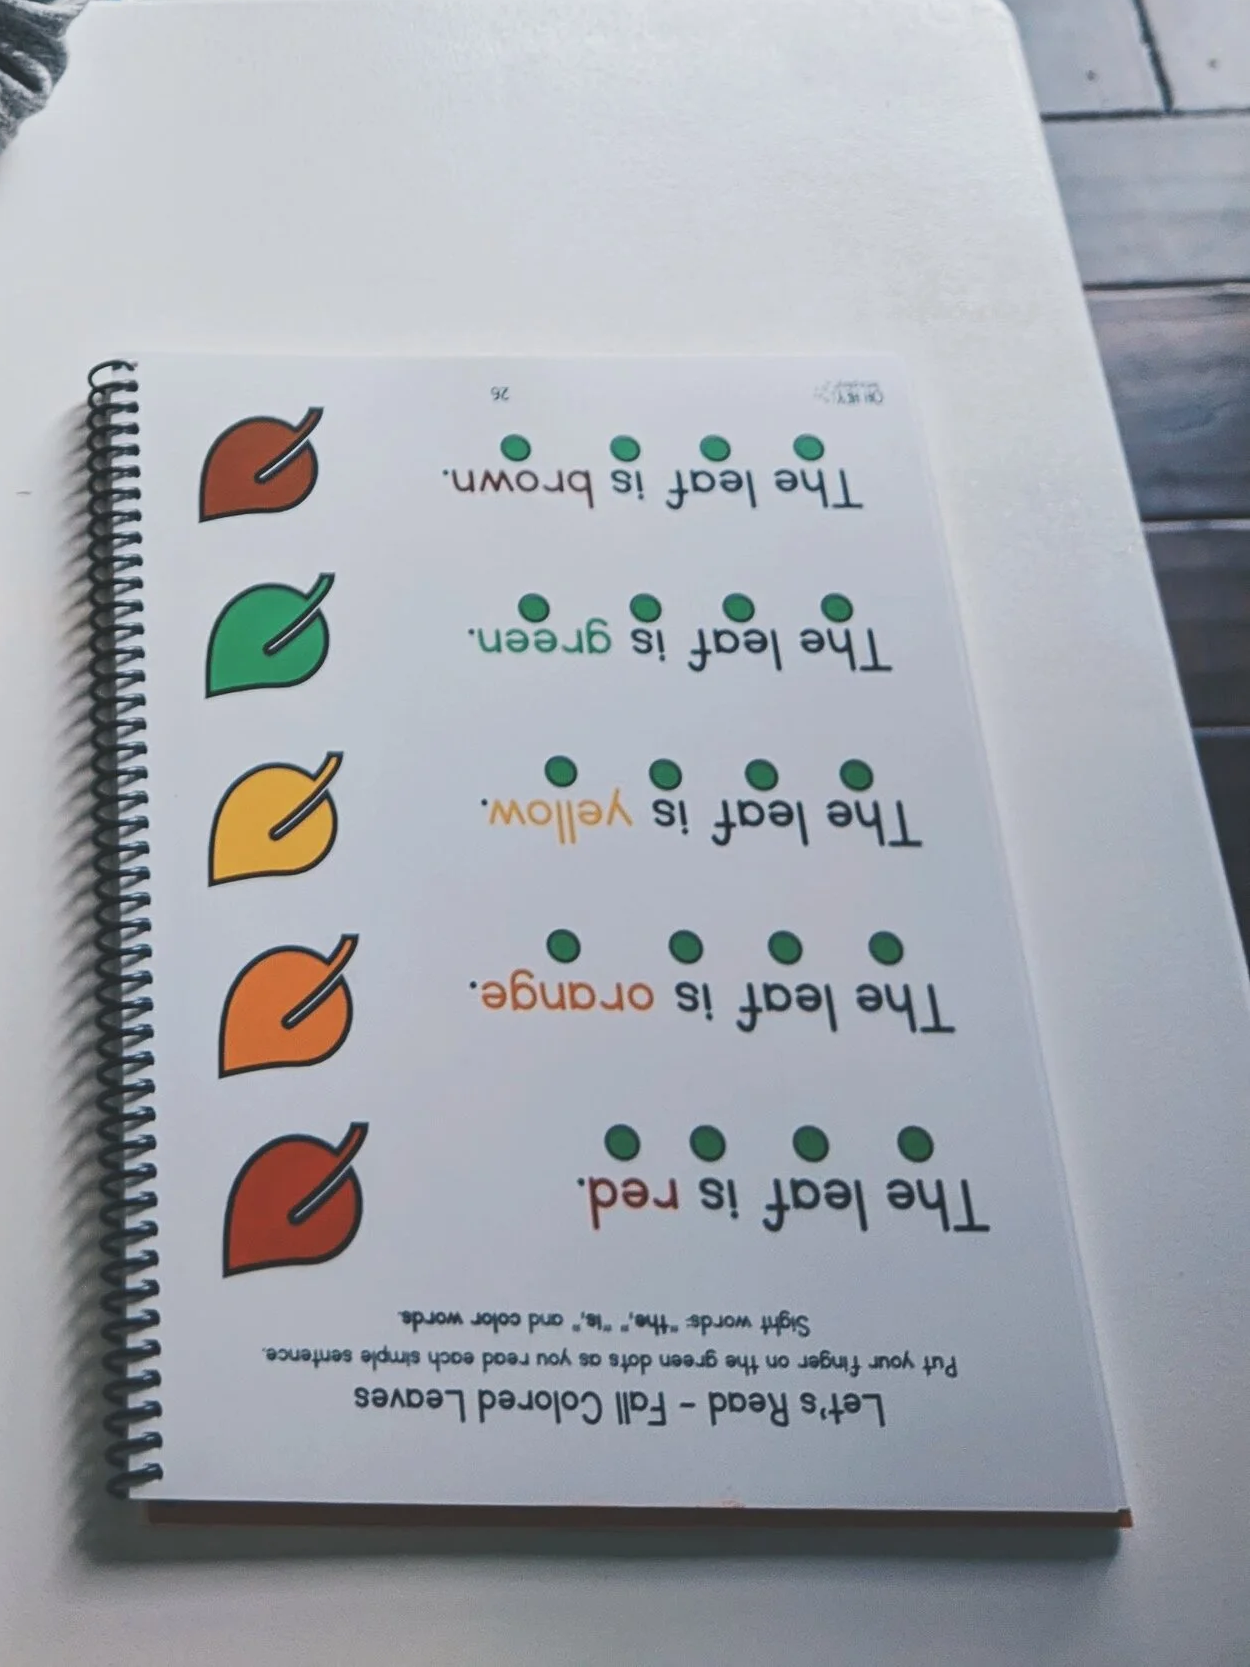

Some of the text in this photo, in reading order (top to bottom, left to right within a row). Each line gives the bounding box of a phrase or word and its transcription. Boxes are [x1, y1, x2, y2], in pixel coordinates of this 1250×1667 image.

[490, 384, 511, 403] 26
[442, 468, 864, 511] The leaf is brown.
[468, 617, 893, 673] The leaf is green.
[481, 789, 923, 848] The leaf is yellow.
[469, 969, 956, 1034] The leaf is orange.
[577, 1177, 990, 1233] The leaf is red.
[397, 1310, 464, 1333] words.
[470, 1312, 522, 1334] color
[528, 1313, 564, 1334] and
[760, 1310, 811, 1338] Sight
[262, 1345, 958, 1378] Put your finger on the green dots as you read each simple sentence.
[354, 1387, 466, 1423] Leaves
[478, 1389, 603, 1425] Colored
[615, 1391, 667, 1426] Fall
[708, 1391, 790, 1427] Read
[800, 1392, 886, 1428] Let's
